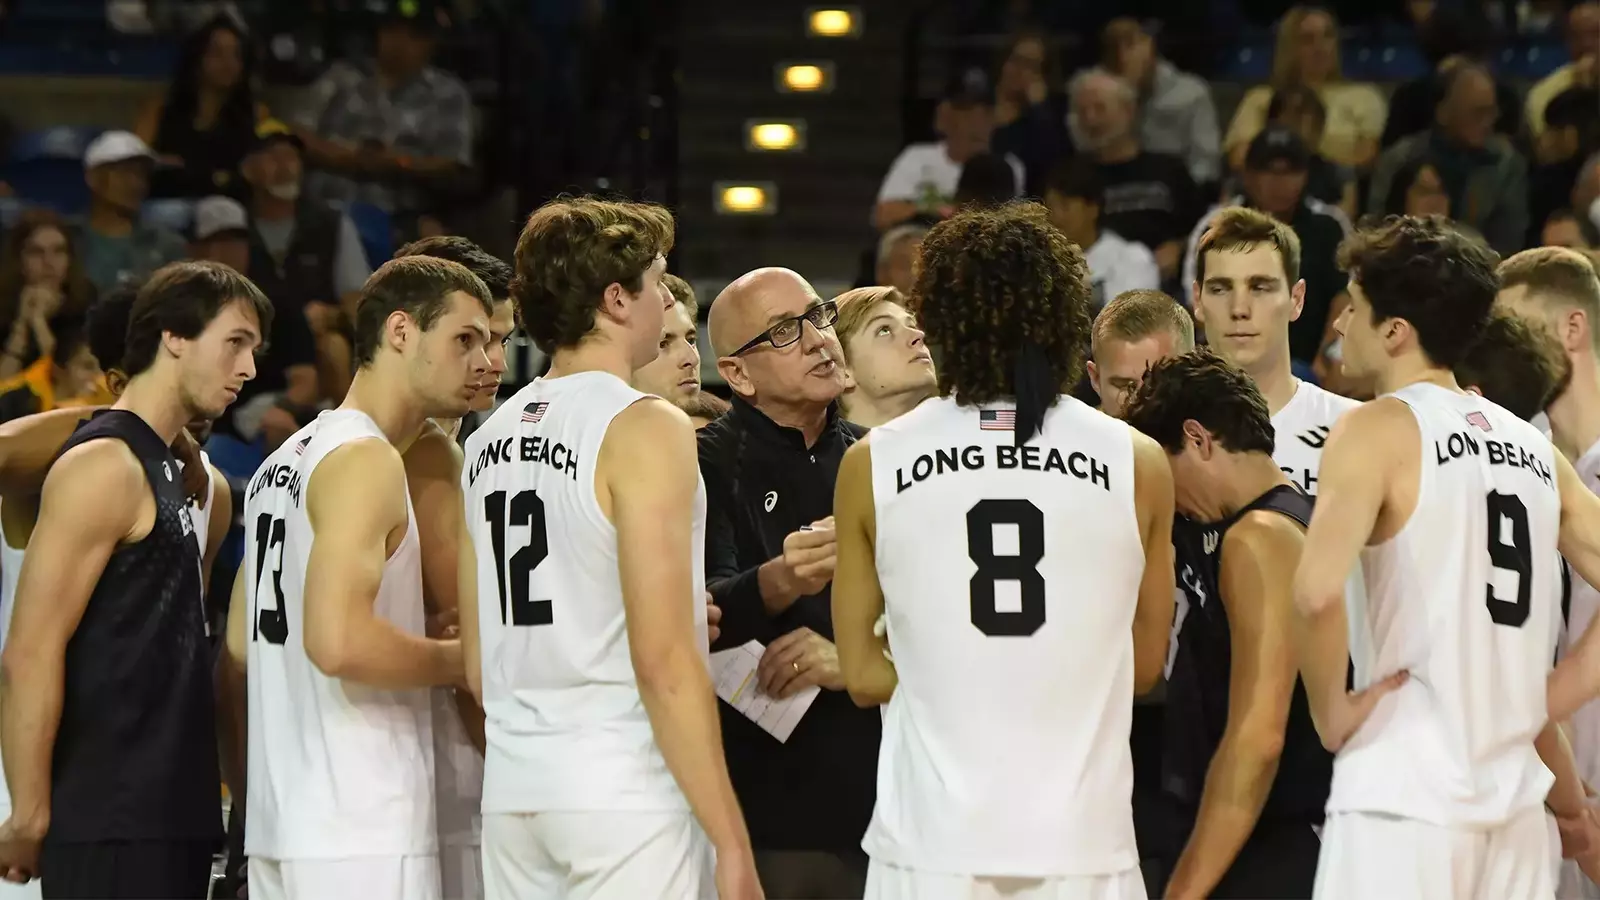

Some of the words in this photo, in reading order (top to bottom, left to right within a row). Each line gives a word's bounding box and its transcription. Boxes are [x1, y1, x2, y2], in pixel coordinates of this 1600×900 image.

[896, 445, 985, 494] LONG
[996, 445, 1110, 491] BEACH
[252, 512, 289, 646] 13
[484, 489, 553, 627] 12
[966, 498, 1046, 636] 8
[1486, 488, 1532, 628] 9
